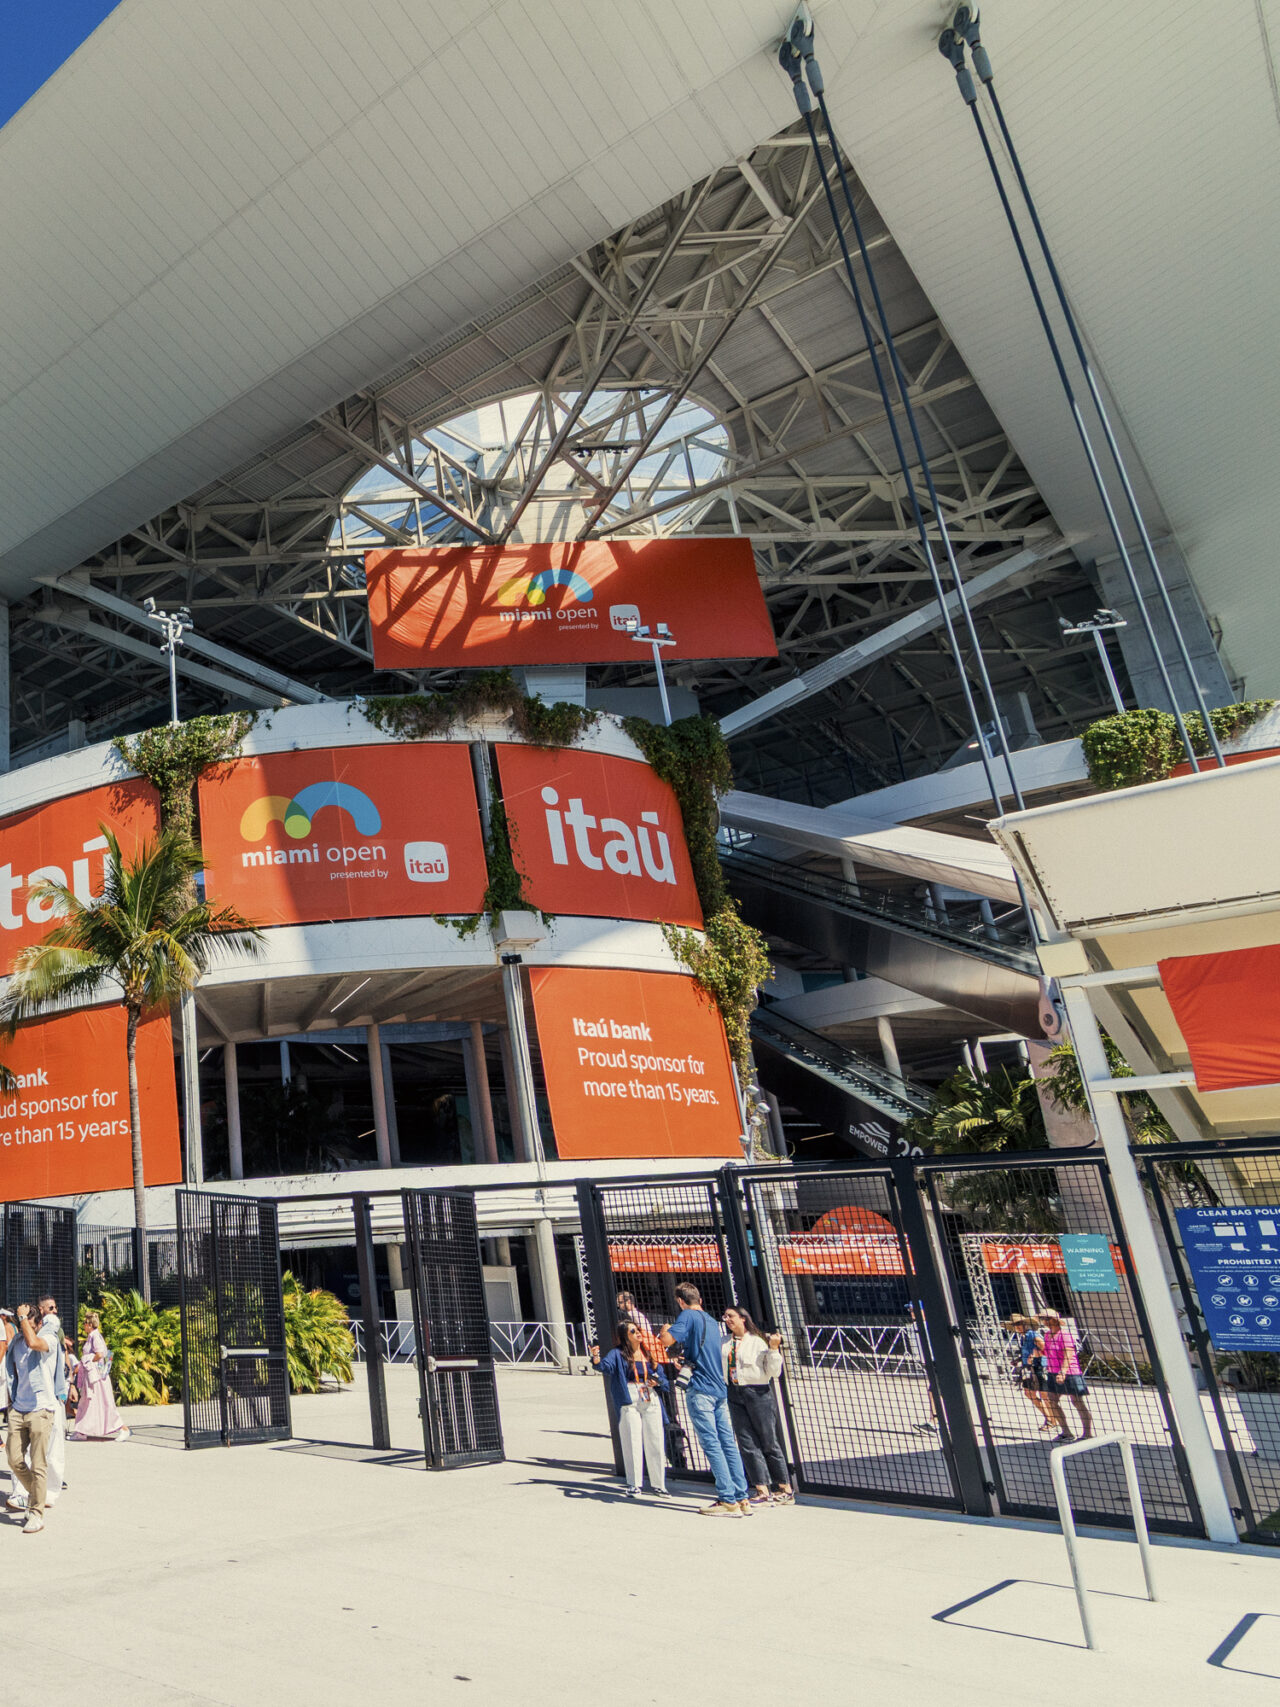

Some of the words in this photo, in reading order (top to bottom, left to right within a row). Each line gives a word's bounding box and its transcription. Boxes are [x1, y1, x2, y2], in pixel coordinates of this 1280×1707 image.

[499, 607, 552, 622] miami
[556, 607, 597, 622] open
[540, 786, 678, 885] itaú
[241, 843, 320, 867] miami
[326, 844, 387, 865] open
[409, 859, 445, 874] itaú
[329, 869, 376, 880] presented
[377, 869, 389, 880] by
[572, 1017, 608, 1038] Itaú
[609, 1019, 653, 1042] bank
[577, 1047, 628, 1068] Proud
[629, 1053, 686, 1074] sponsor
[687, 1055, 705, 1075] for
[20, 1094, 88, 1119] sponsor
[91, 1088, 119, 1107] for
[583, 1080, 627, 1098] more
[628, 1079, 665, 1100] than
[665, 1082, 682, 1102] 15
[683, 1087, 720, 1106] years.
[15, 1126, 53, 1145] than
[56, 1121, 75, 1141] 15
[78, 1119, 132, 1142] years.
[848, 1124, 889, 1156] EMPOWER
[1196, 1209, 1229, 1217] CLEAR
